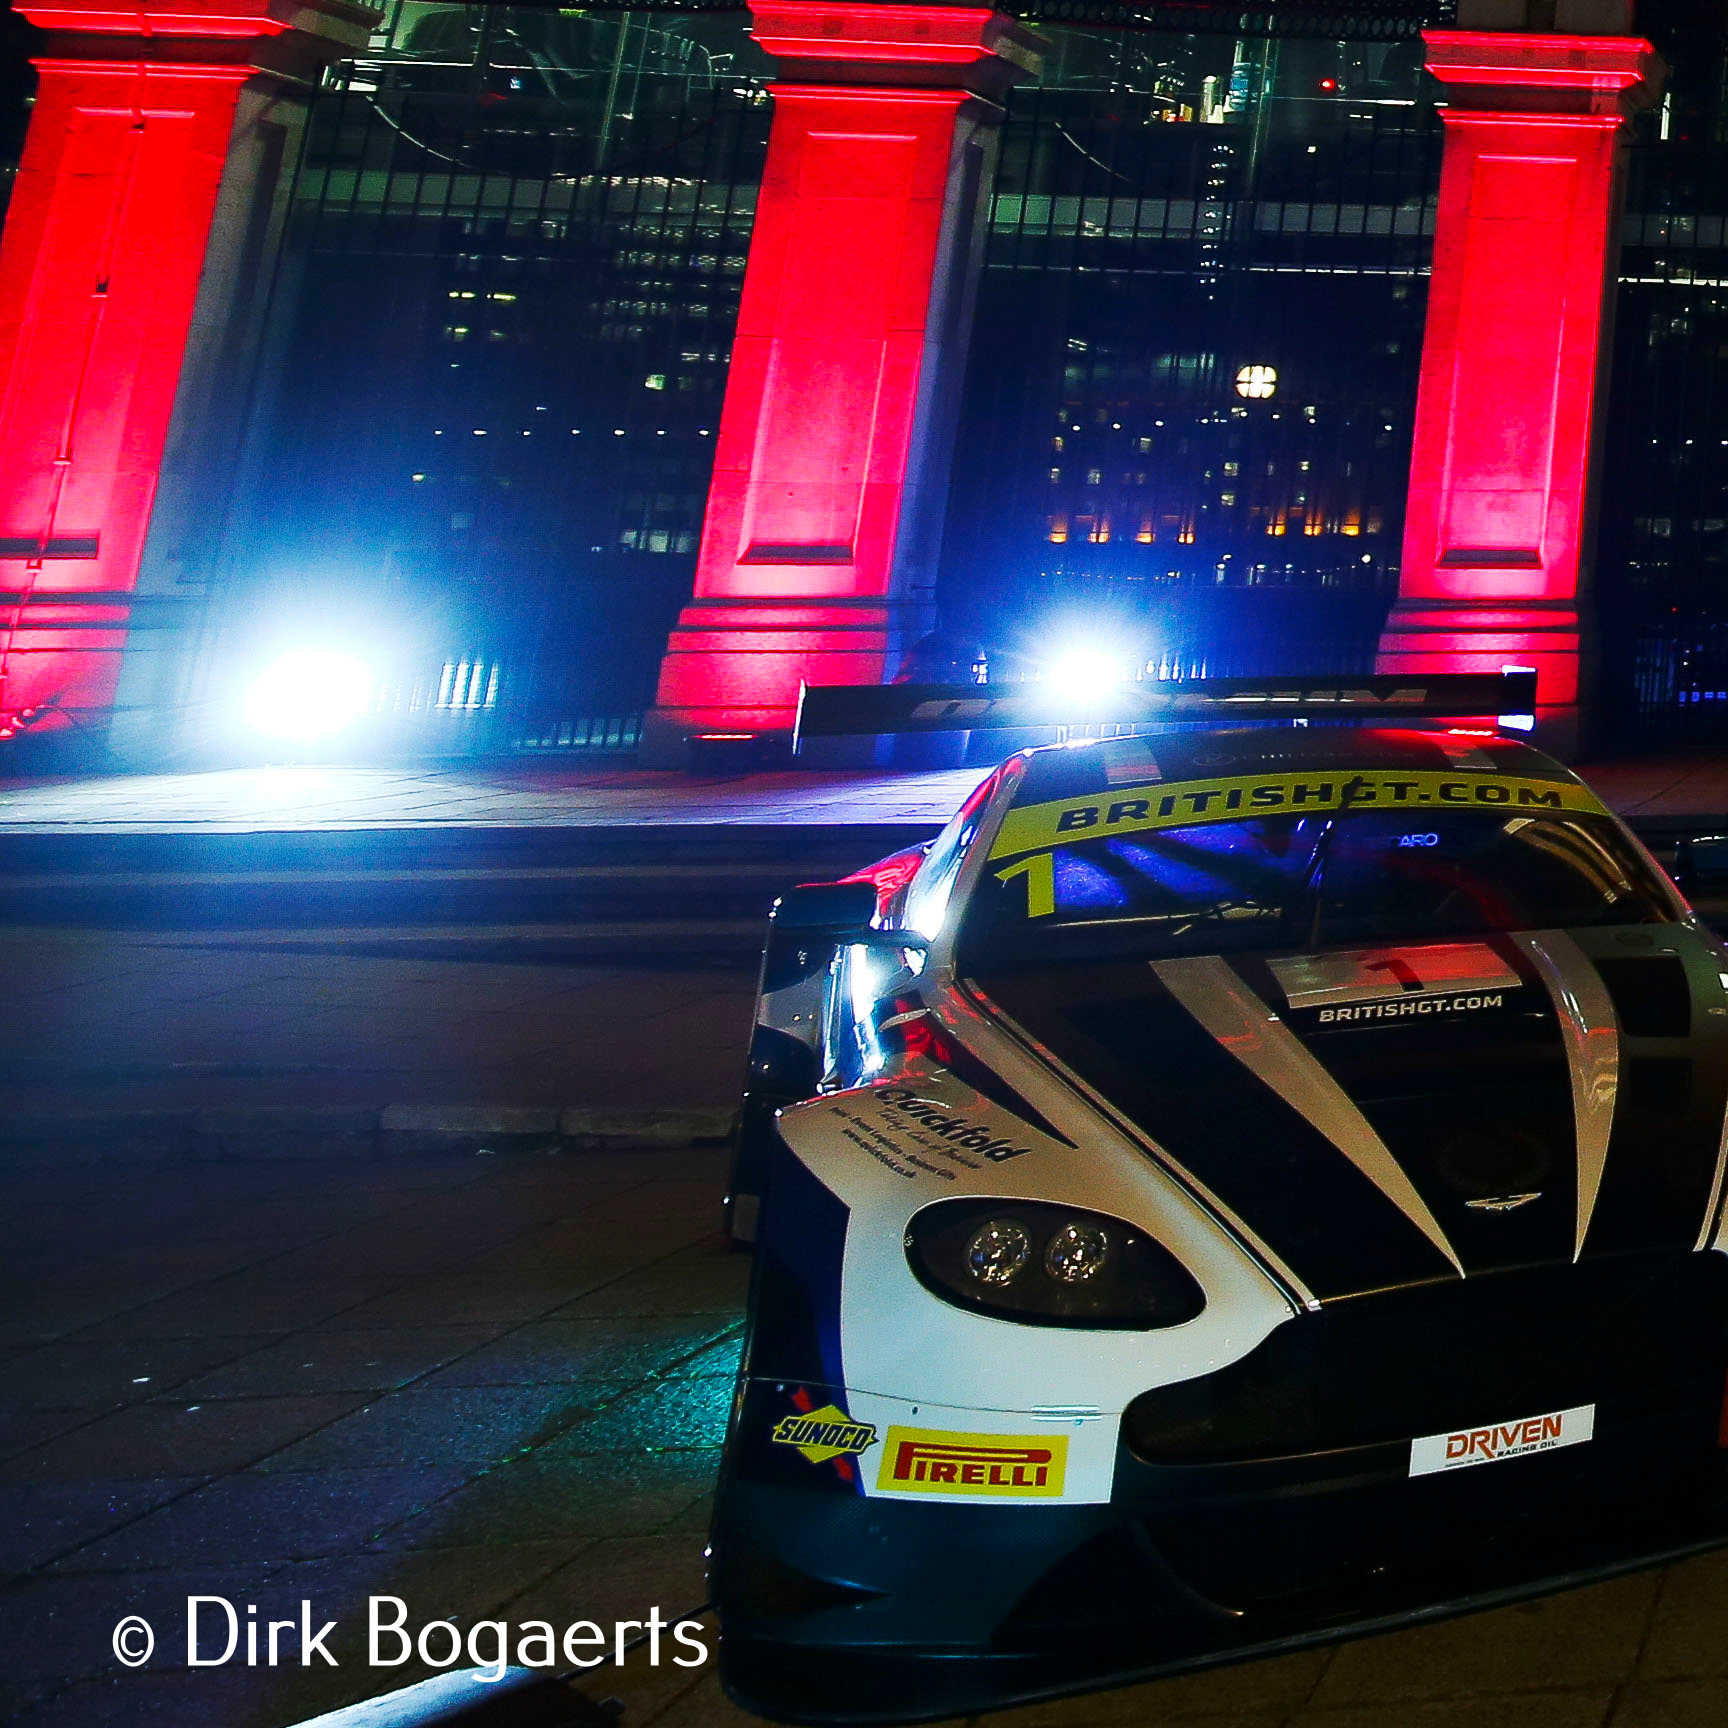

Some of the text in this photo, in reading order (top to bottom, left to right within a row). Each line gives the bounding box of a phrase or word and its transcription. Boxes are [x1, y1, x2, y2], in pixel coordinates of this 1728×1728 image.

[1055, 780, 1563, 834] BRITISHGT.COM
[998, 853, 1055, 918] 1
[1366, 959, 1424, 993] 1
[1318, 995, 1503, 1023] BRITISHGT.COM
[875, 1087, 1031, 1162] Quickfold
[777, 1419, 871, 1452] SUNOCO
[1446, 1414, 1562, 1459] DRIVEN
[893, 1440, 1052, 1486] PIRELLI
